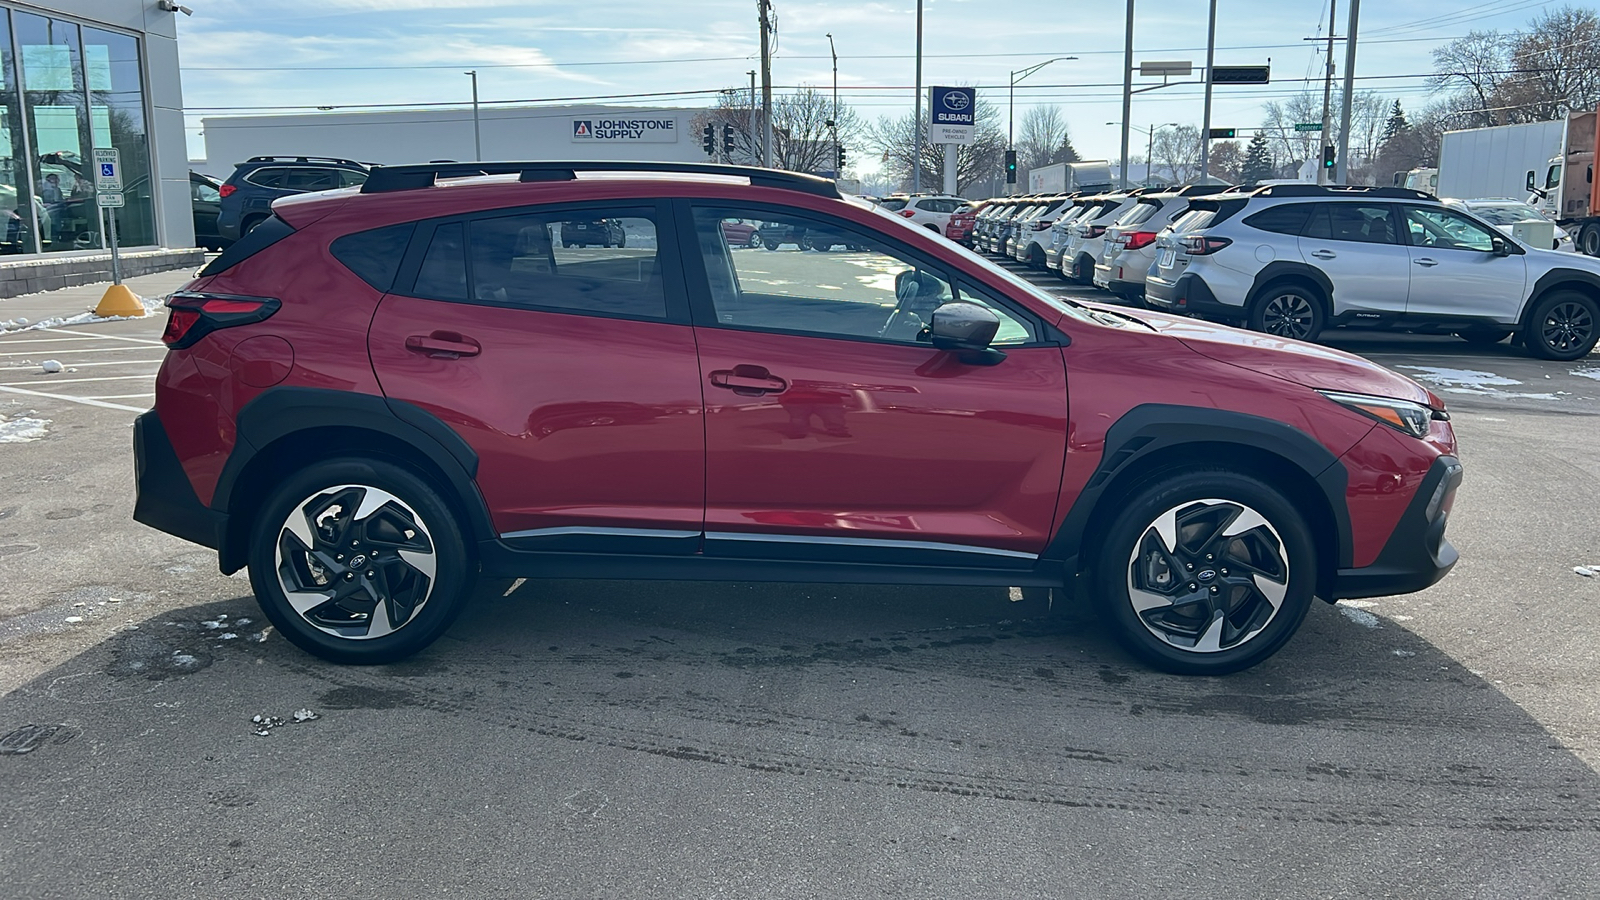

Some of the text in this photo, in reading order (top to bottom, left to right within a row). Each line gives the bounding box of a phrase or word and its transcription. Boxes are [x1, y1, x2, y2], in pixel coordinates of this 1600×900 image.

[938, 113, 972, 122] SUBARU
[594, 120, 674, 129] JOHNSTONE
[595, 129, 644, 138] SUPPLY
